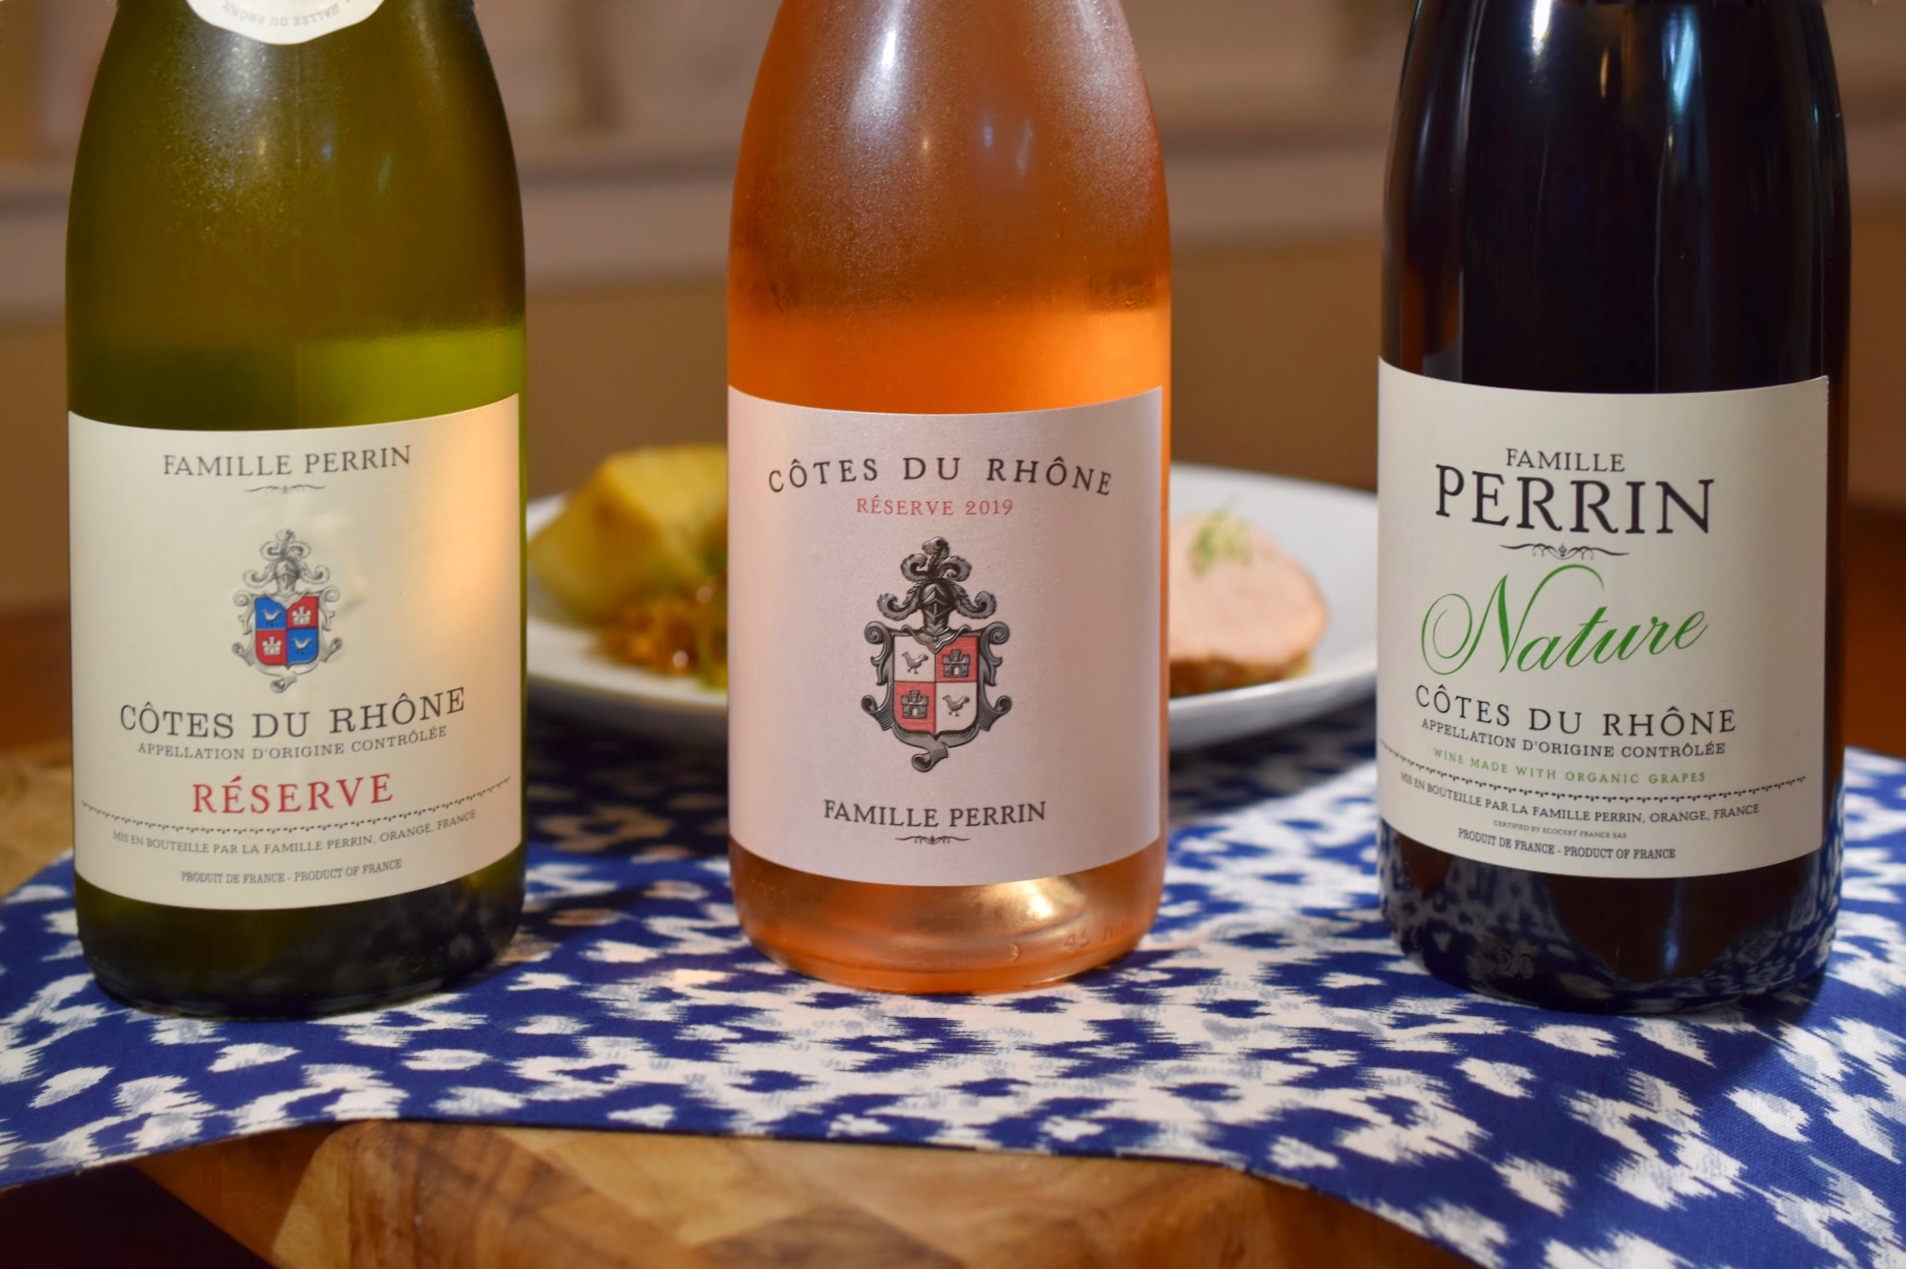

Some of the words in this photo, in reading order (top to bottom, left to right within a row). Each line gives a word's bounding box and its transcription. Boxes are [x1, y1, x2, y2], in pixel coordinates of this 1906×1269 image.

[221, 0, 265, 24] RHÔNE
[270, 17, 288, 26] DU
[293, 2, 341, 27] VALLÉE
[163, 454, 292, 476] FAMILLE
[304, 445, 411, 473] PERRIN
[769, 459, 878, 492] CÔTES
[903, 457, 961, 480] DU
[986, 456, 1112, 496] RHÔNE
[1506, 448, 1625, 472] FAMILLE
[856, 495, 954, 516] RÉSERVE
[965, 499, 1014, 516] 2019
[1436, 464, 1714, 533] PERRIN
[1421, 564, 1708, 675] Nature
[120, 702, 234, 739] CÔTES
[252, 711, 310, 738] DU
[329, 687, 464, 734] RHÔNE
[1416, 684, 1510, 727] CÔTES
[1529, 708, 1582, 735] DU
[1603, 706, 1736, 736] RHÔNE
[138, 743, 245, 759] APPELLATION
[252, 743, 345, 759] D'ORIGINE
[352, 726, 447, 753] CONTRÔLÉE
[1422, 718, 1516, 748] APPELLATION
[1522, 739, 1614, 757] D'ORIGINE
[1621, 741, 1726, 758] CONTRÔLÉE
[1433, 748, 1464, 764] WINE
[1471, 758, 1508, 773] MADE
[1516, 766, 1556, 779] WITH
[1565, 770, 1639, 783] ORGANIC
[1649, 772, 1705, 784] GRAPES
[192, 773, 393, 814] RÉSERVE
[1401, 772, 1412, 785] MIS
[1414, 778, 1425, 790] EN
[1427, 784, 1482, 806] BOUTEILLE
[1485, 799, 1508, 811] PAR
[1512, 804, 1528, 814] LA
[1533, 807, 1590, 821] FAMILLE
[1595, 813, 1645, 824] PERRIN,
[1650, 811, 1710, 823] ORANGE,
[1714, 804, 1760, 819] FRANCE
[824, 799, 939, 827] FAMILLE
[949, 801, 1046, 827] PERRIN
[1493, 820, 1529, 832] CERTIFIED
[113, 830, 128, 843] MIS
[131, 835, 144, 846] EN
[147, 837, 210, 853] BOUTEILLE
[213, 844, 239, 854] PAR
[243, 844, 259, 854] LA
[264, 842, 323, 853] FAMILLE
[327, 835, 376, 849] PERRIN,
[380, 825, 434, 842] ORANGE,
[437, 809, 476, 830] FRANCE
[1458, 828, 1497, 846] PRODUIT
[1499, 837, 1512, 849] DE
[1515, 840, 1555, 855] FRANCE
[1564, 846, 1613, 859] PRODUCT
[1616, 849, 1630, 859] OF
[1633, 849, 1676, 859] FRANCE
[181, 871, 223, 883] PRODUIT
[226, 873, 240, 883] DE
[243, 873, 285, 883] FRANCE
[295, 868, 343, 882] PRODUCT
[346, 866, 359, 877] OF
[362, 859, 402, 874] FRANCE
